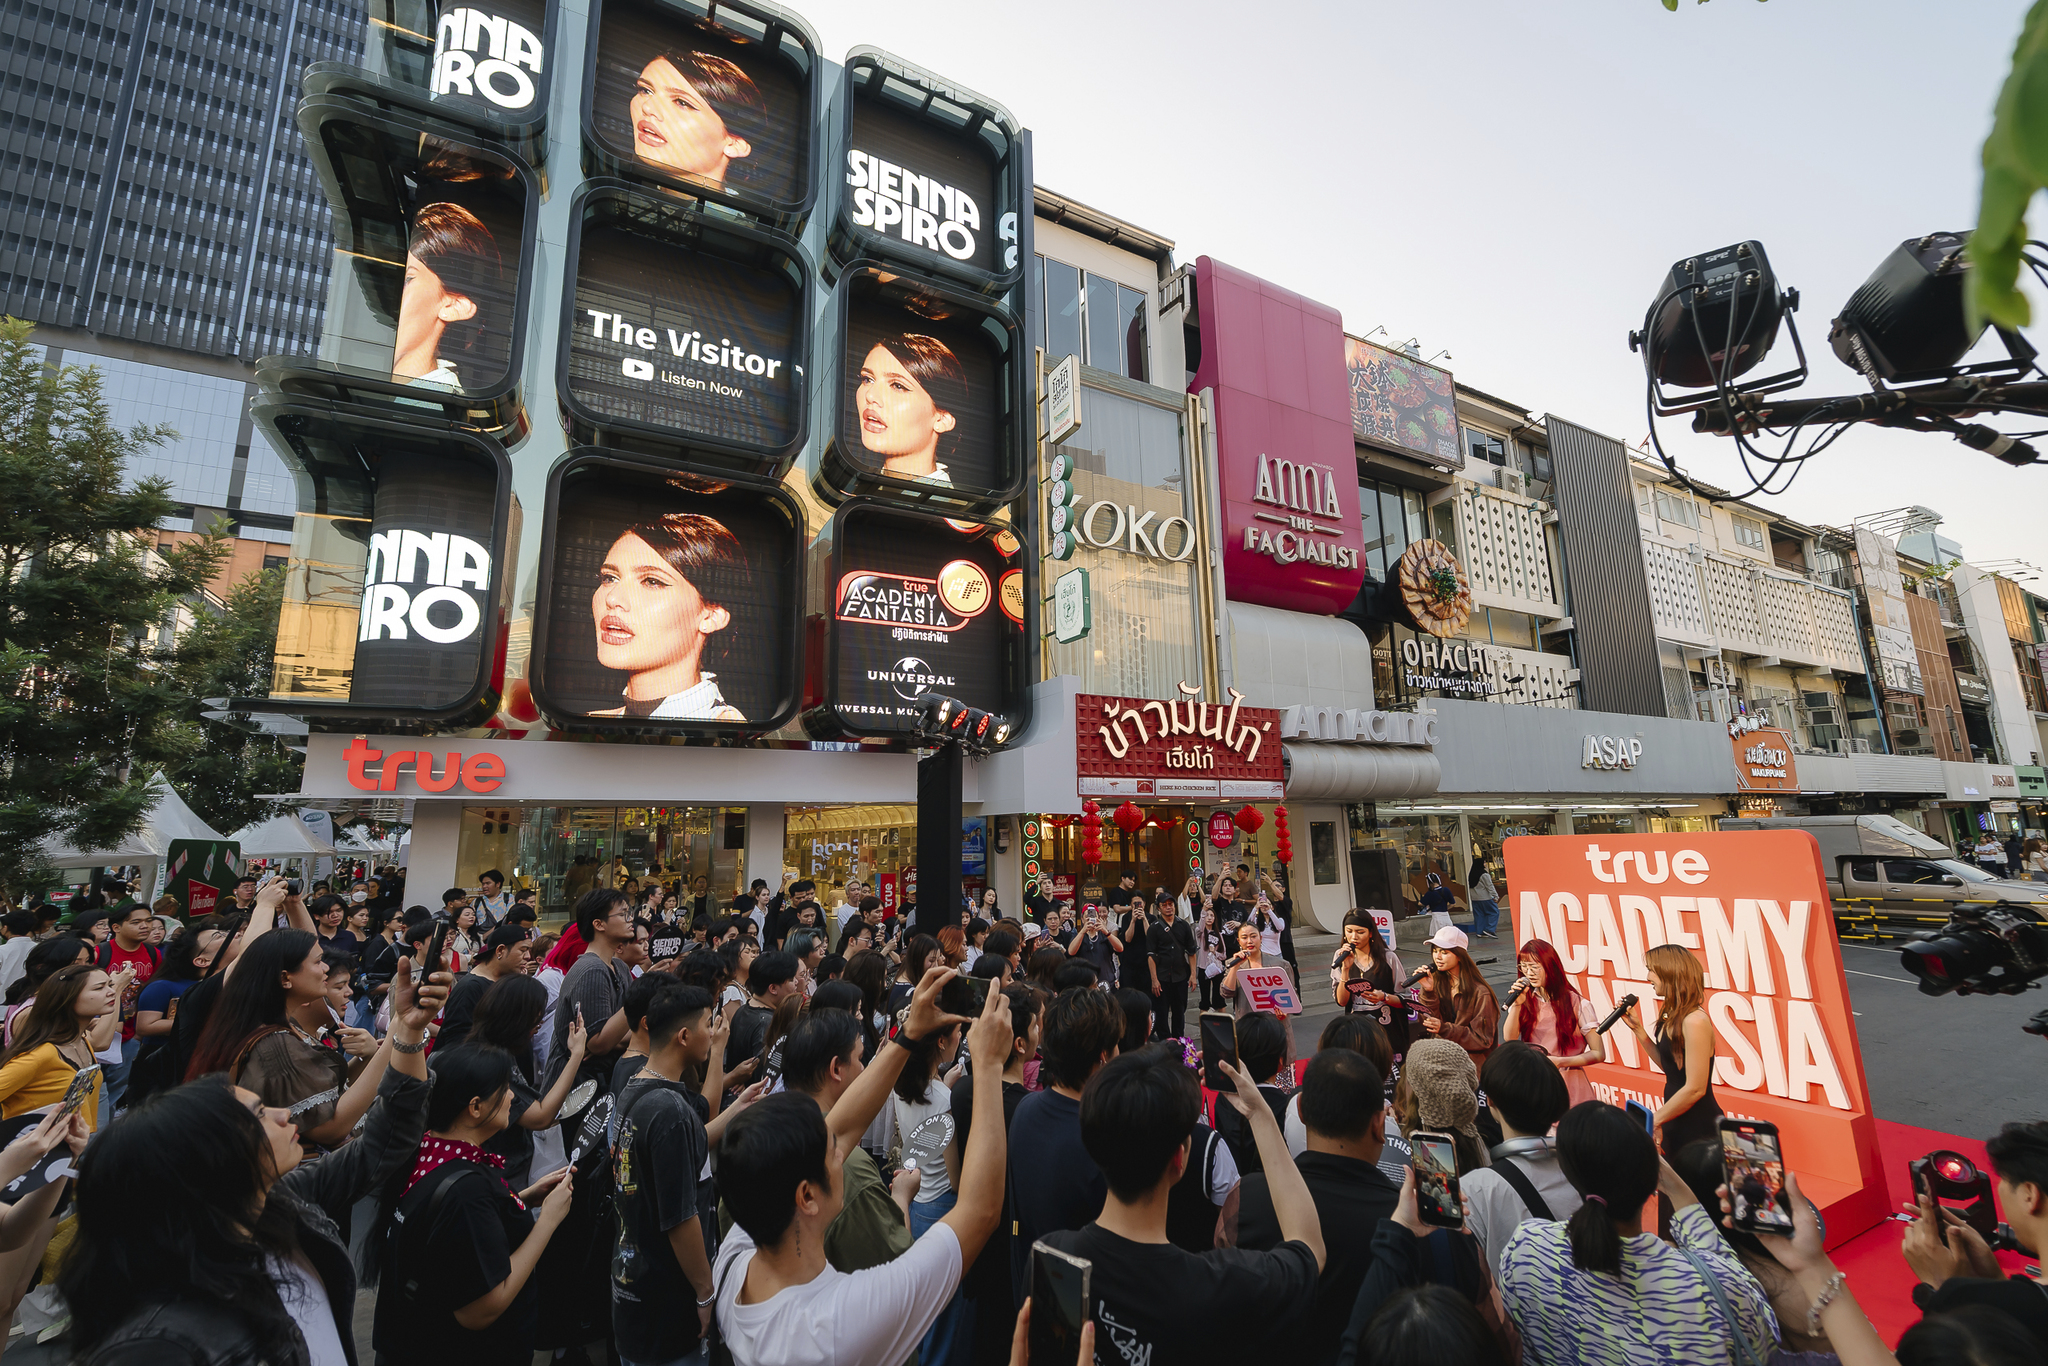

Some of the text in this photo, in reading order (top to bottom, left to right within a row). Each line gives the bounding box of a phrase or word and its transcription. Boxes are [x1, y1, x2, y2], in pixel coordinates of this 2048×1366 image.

[846, 149, 980, 231] SIENNA
[852, 188, 975, 260] SPIRO
[587, 309, 781, 379] The Visitor
[661, 370, 743, 399] Listen Now
[1288, 514, 1314, 533] THE
[1244, 526, 1359, 570] FACIALIST
[903, 579, 929, 593] true
[849, 585, 938, 610] ACADEMY
[1403, 638, 1491, 675] OHACHI
[867, 670, 955, 686] UNIVERSAL
[1099, 680, 1272, 762] ข้าวมันไก่
[1165, 745, 1214, 770] เฮียโก้
[1583, 734, 1644, 769] ASAP
[342, 739, 507, 793] true
[1585, 844, 1710, 885] true
[884, 882, 894, 908] true
[652, 937, 682, 949] SIENNA
[652, 946, 679, 957] SPIRO
[1519, 891, 1812, 1000] ACADEMY
[1247, 974, 1284, 988] true
[1252, 989, 1294, 1009] 5G
[1378, 1005, 1392, 1025] 3
[583, 1105, 596, 1122] DIE
[925, 1115, 940, 1126] ON
[939, 1114, 953, 1129] THIS
[910, 1123, 925, 1139] DIE
[939, 1128, 953, 1148] HILL
[1386, 1137, 1412, 1157] THIS
